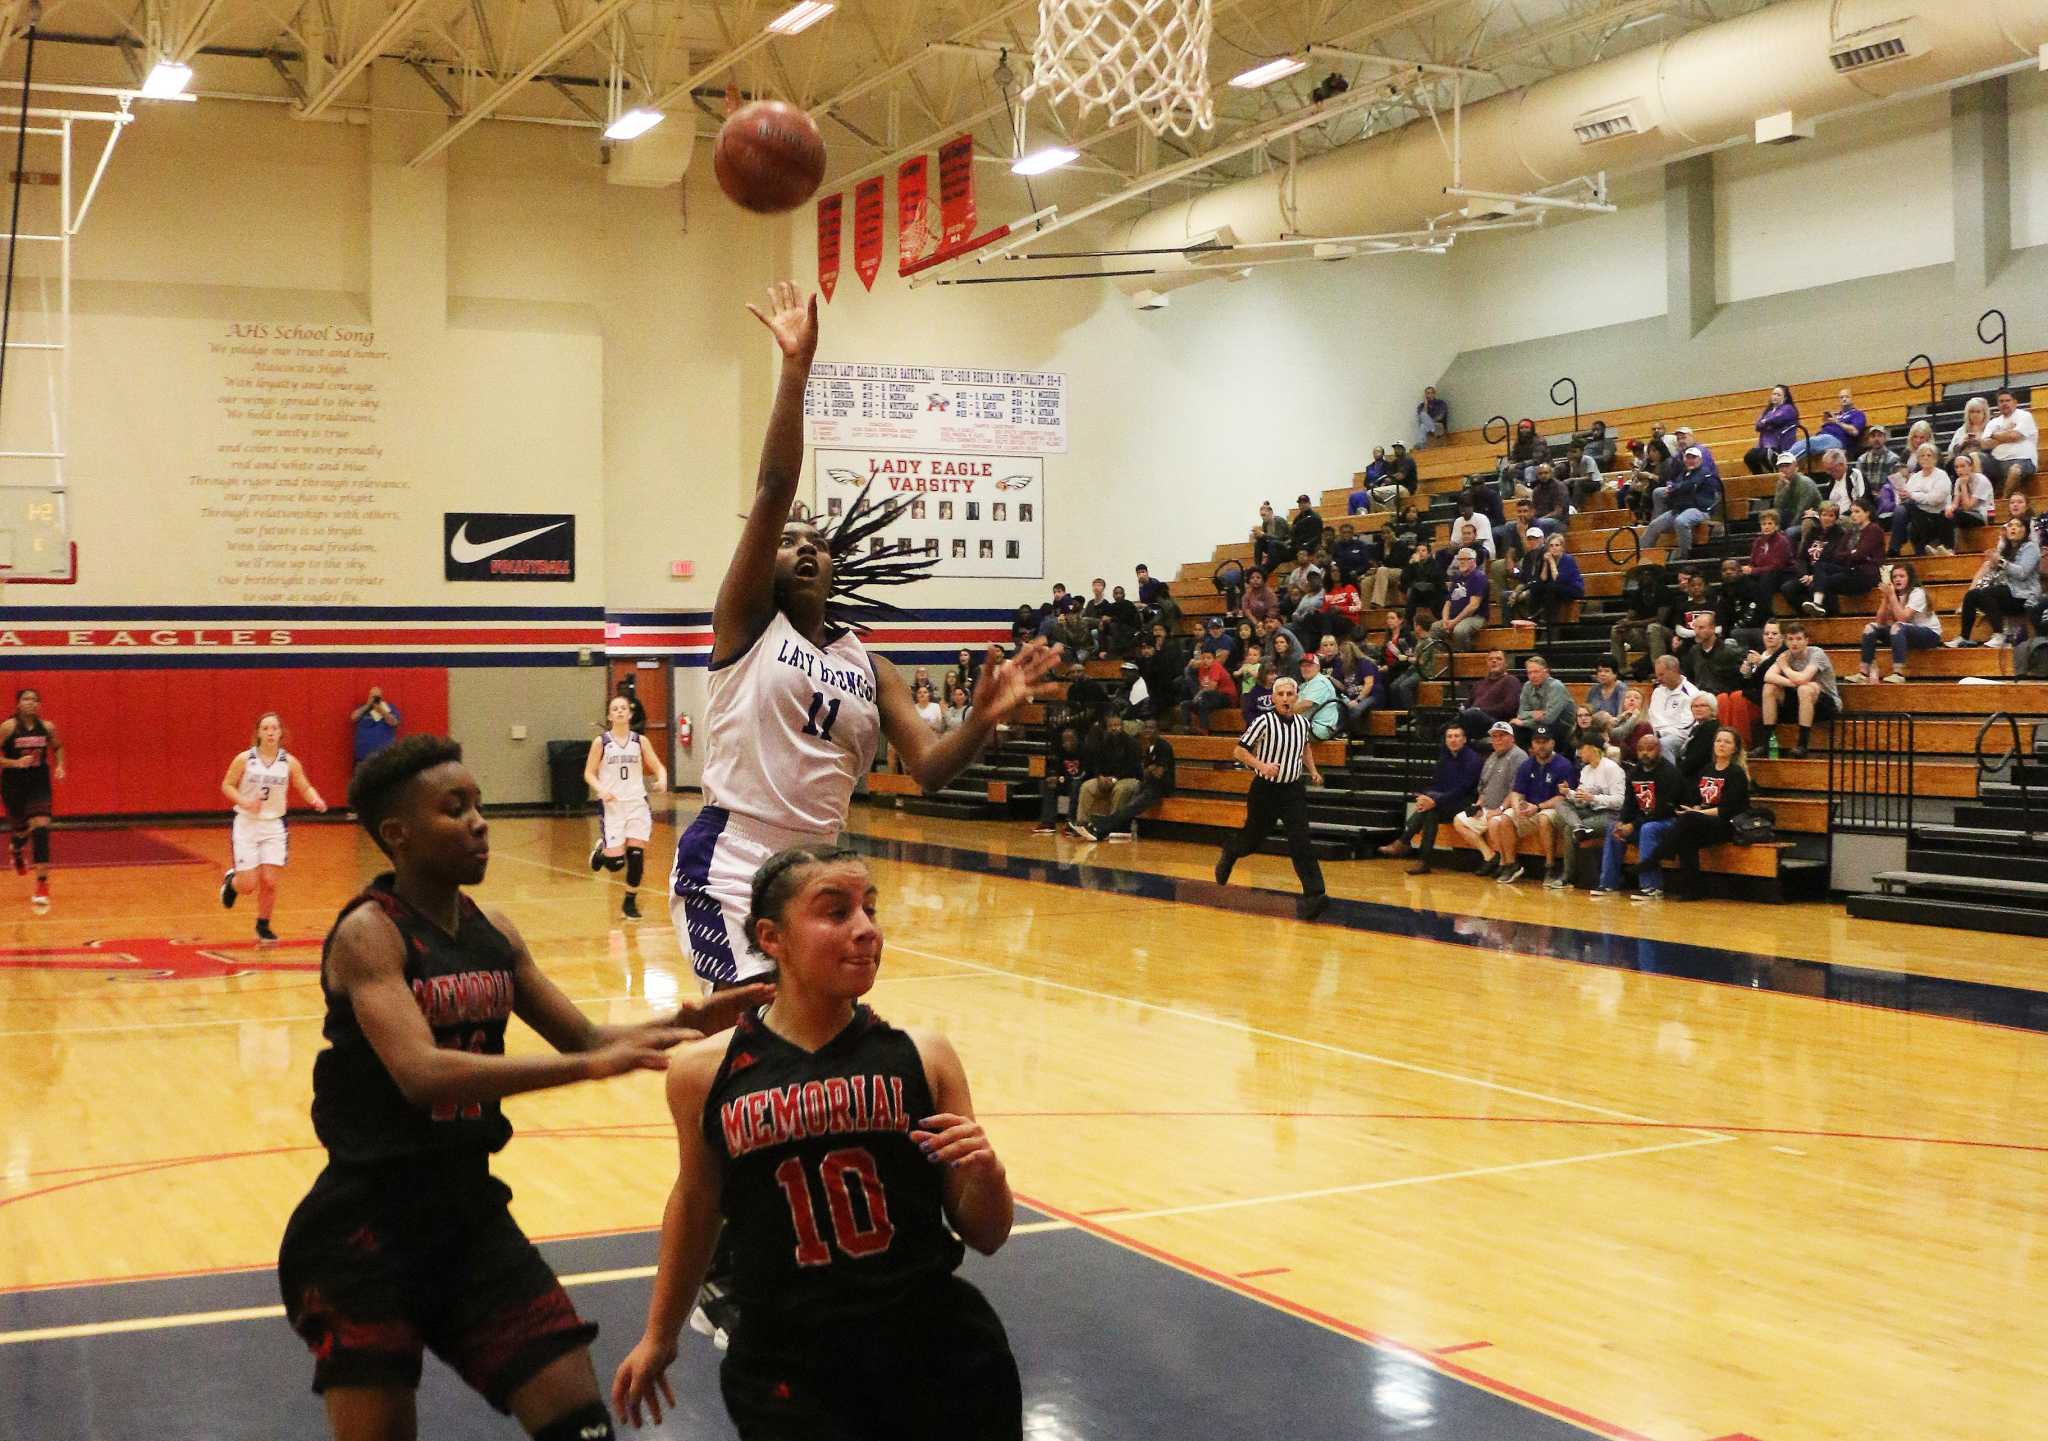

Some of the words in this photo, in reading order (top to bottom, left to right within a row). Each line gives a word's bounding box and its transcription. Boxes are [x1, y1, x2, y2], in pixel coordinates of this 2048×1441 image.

[225, 323, 268, 338] AHS
[273, 325, 328, 340] School
[334, 328, 375, 347] Song
[296, 348, 324, 356] trust
[328, 349, 350, 358] and
[302, 379, 325, 390] and
[280, 397, 320, 407] spread
[276, 411, 287, 420] to
[218, 444, 240, 453] and
[254, 461, 277, 470] and
[281, 461, 313, 471] white
[317, 462, 340, 471] and
[869, 458, 922, 475] LADY
[931, 461, 992, 478] EAGLE
[275, 478, 299, 487] and
[888, 477, 976, 494] VARSITY
[300, 543, 323, 552] and
[324, 559, 341, 569] the
[67, 629, 294, 647] EAGLES
[802, 692, 841, 741] 11
[620, 766, 628, 780] 0
[260, 787, 270, 800] 3
[721, 1074, 910, 1159] MEMORIAL
[775, 1147, 895, 1267] 10
